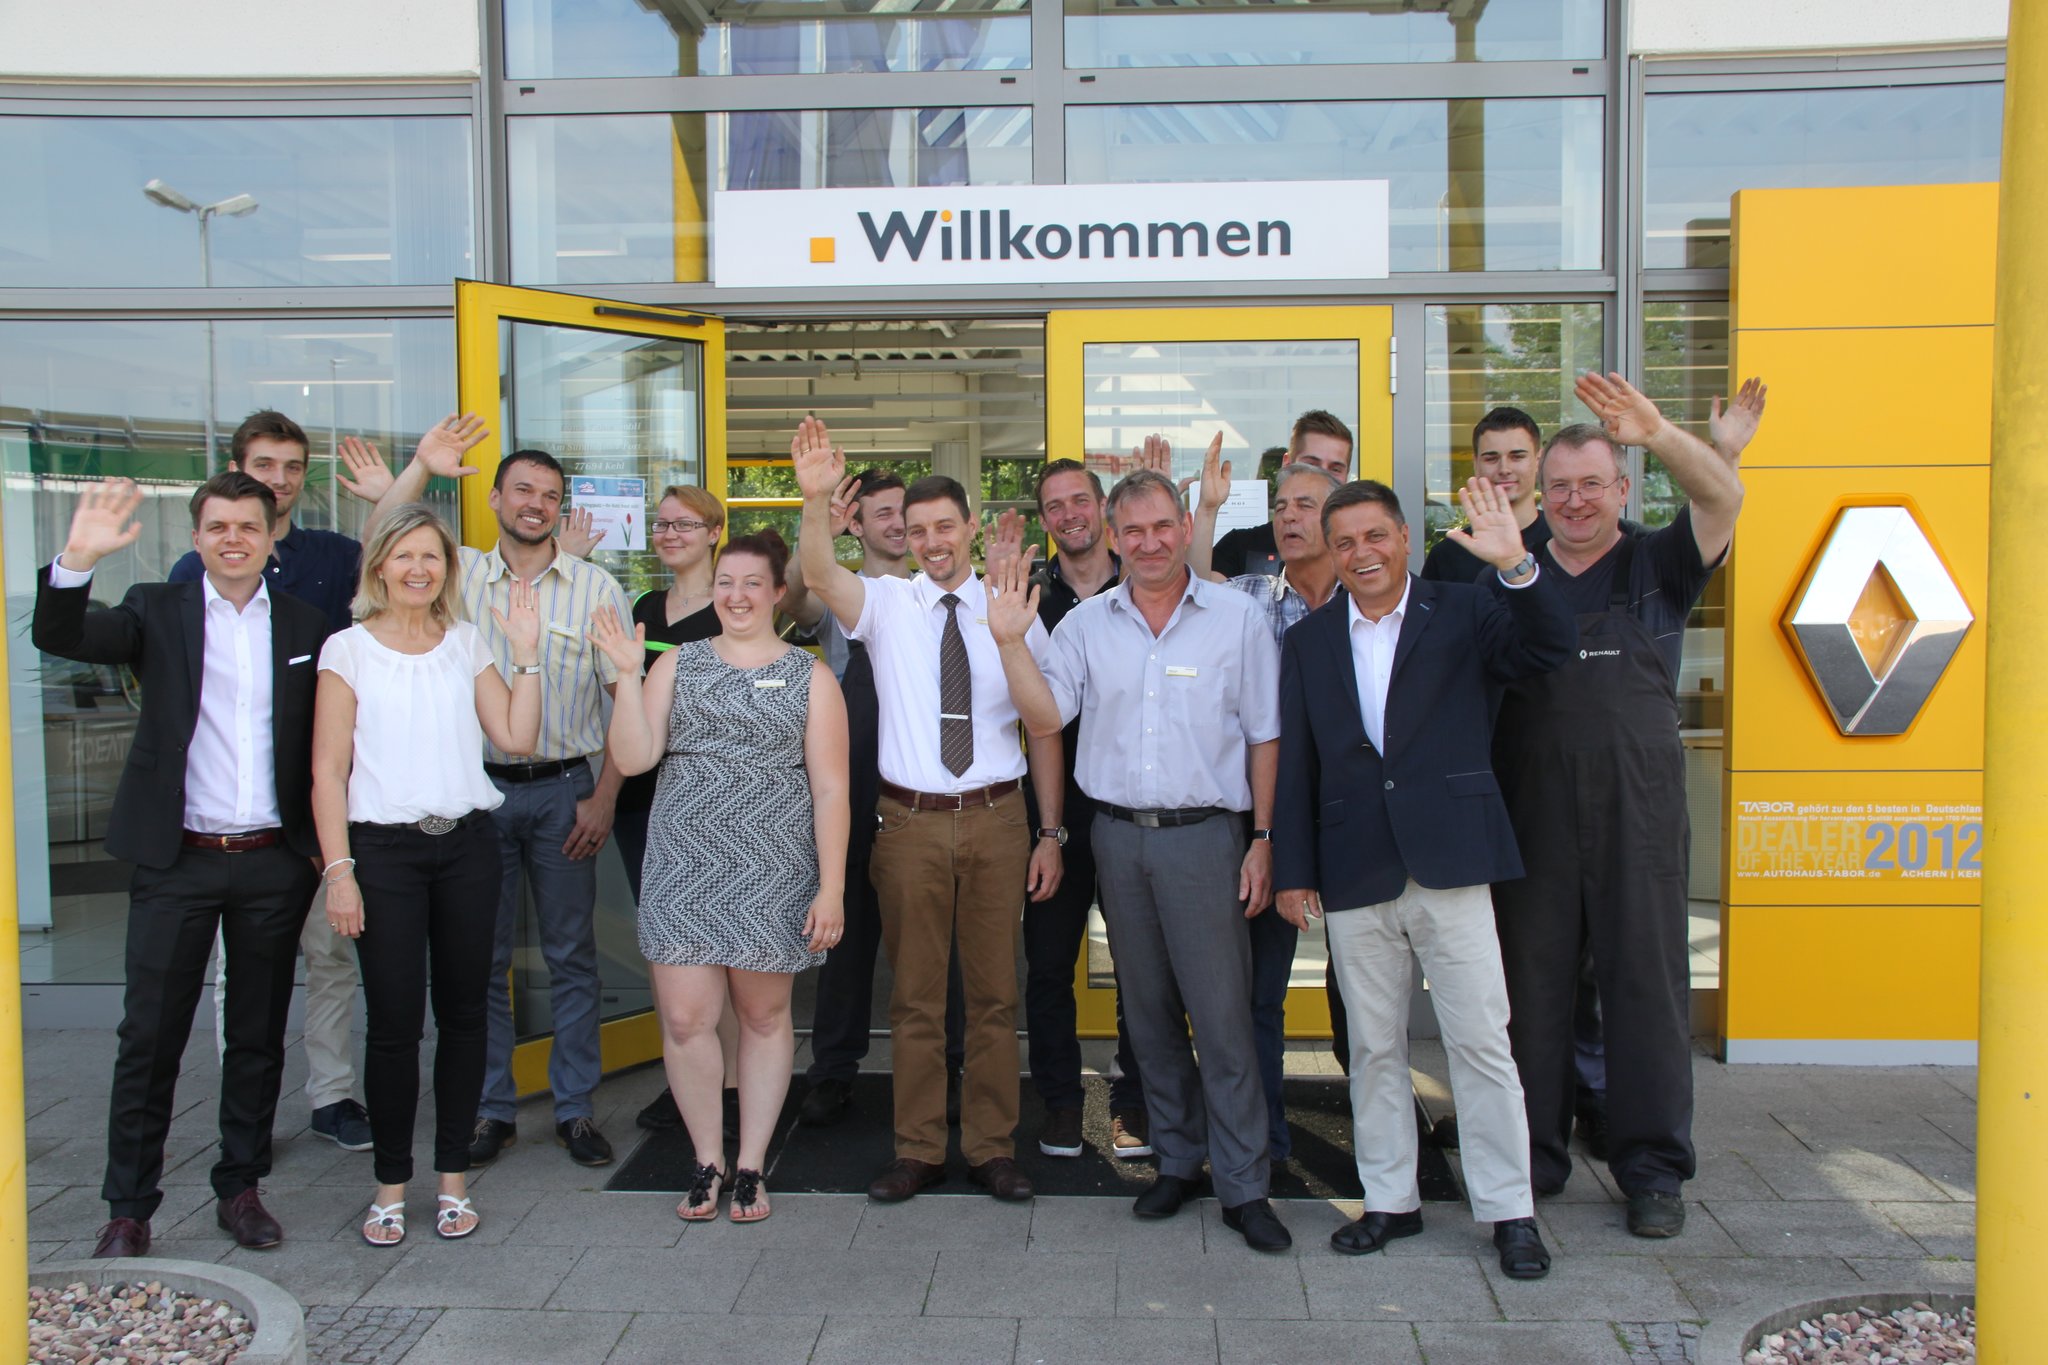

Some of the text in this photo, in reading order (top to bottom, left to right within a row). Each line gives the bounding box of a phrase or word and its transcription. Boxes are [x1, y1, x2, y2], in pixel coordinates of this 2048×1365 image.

[857, 209, 1292, 262] Willkommen
[604, 461, 625, 471] Kehl
[1738, 801, 1795, 813] TABOR
[1797, 804, 1829, 815] gehört
[1831, 805, 1843, 813] zu
[1846, 804, 1864, 813] den
[1866, 804, 1873, 813] 5
[1875, 804, 1908, 813] besten
[1911, 804, 1920, 813] in
[1737, 822, 1861, 852] DEALER
[1864, 822, 1982, 870] 2012
[1737, 852, 1861, 870] OF THE YEAR
[1737, 869, 1881, 878] www.AUTOHAUS-TABOR.de
[1901, 870, 1947, 878] ACHERN
